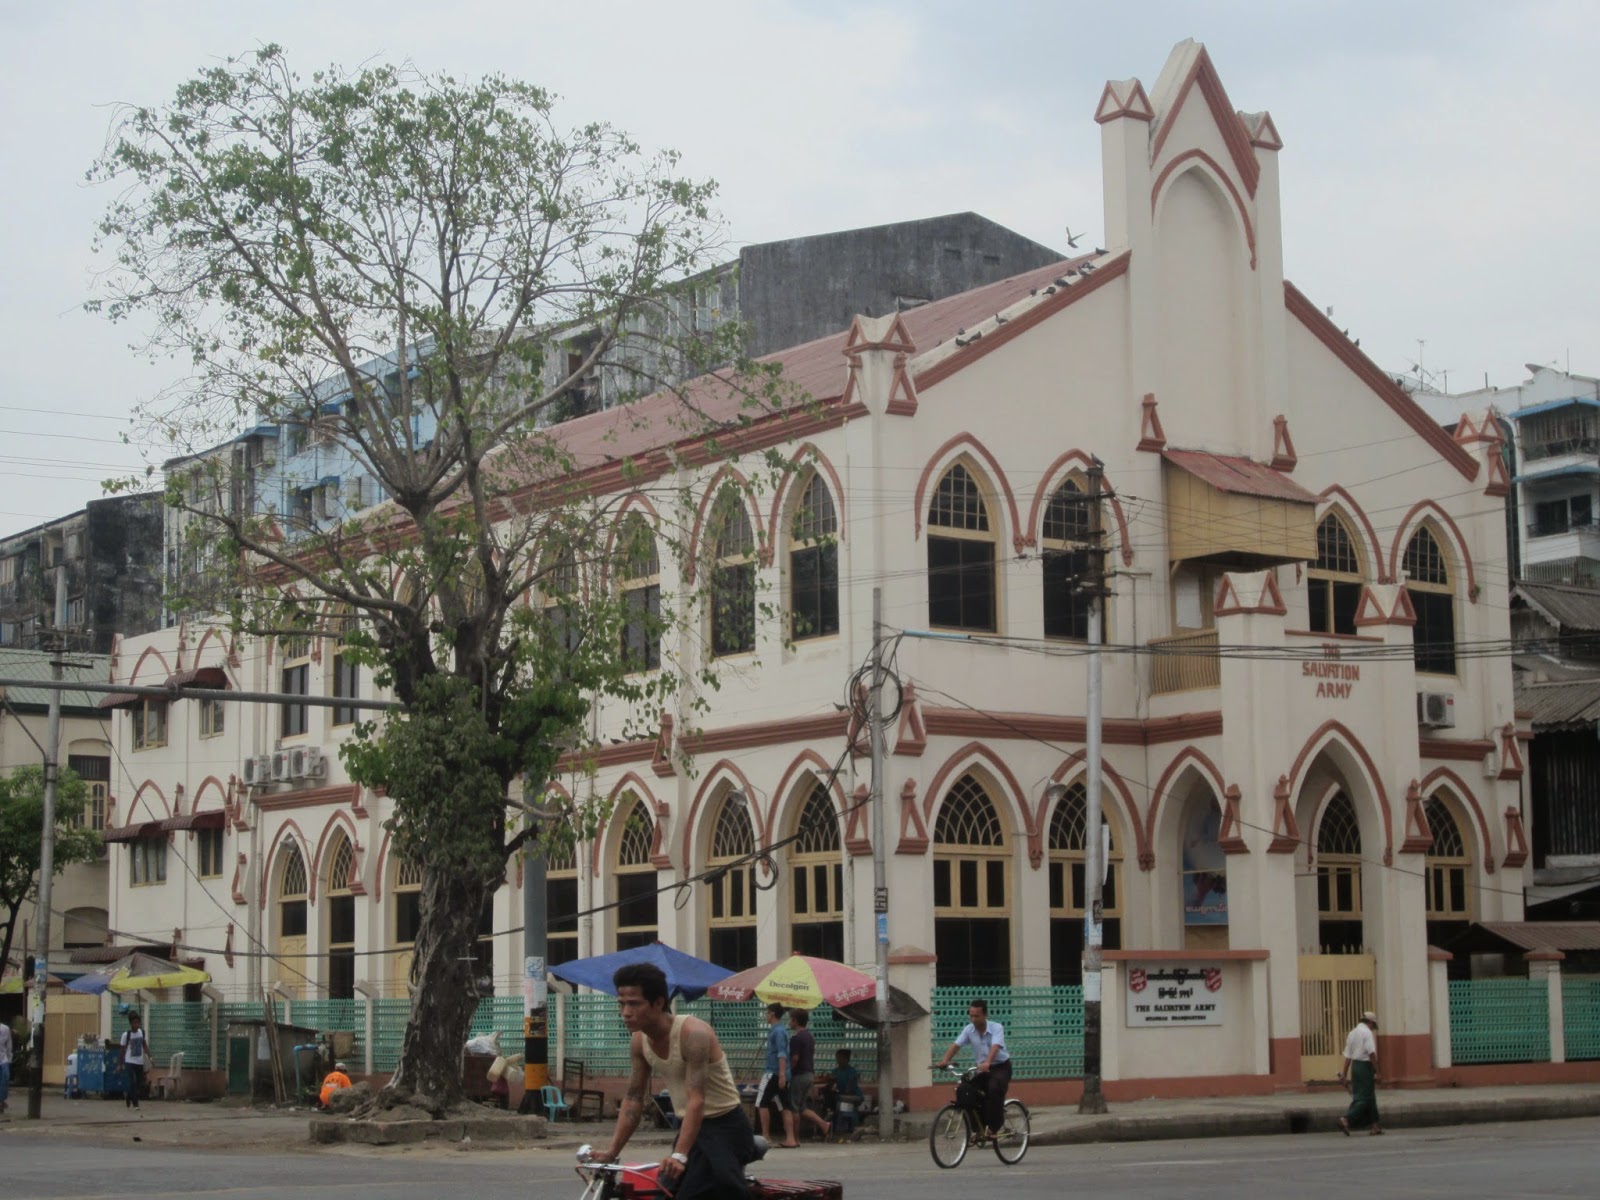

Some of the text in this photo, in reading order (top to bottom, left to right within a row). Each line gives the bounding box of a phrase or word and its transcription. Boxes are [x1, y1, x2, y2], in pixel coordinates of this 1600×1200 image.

[1302, 661, 1360, 681] SALVATION
[1316, 682, 1352, 699] ARMY
[769, 980, 810, 992] Decolgen
[1154, 1004, 1191, 1012] SALVATION
